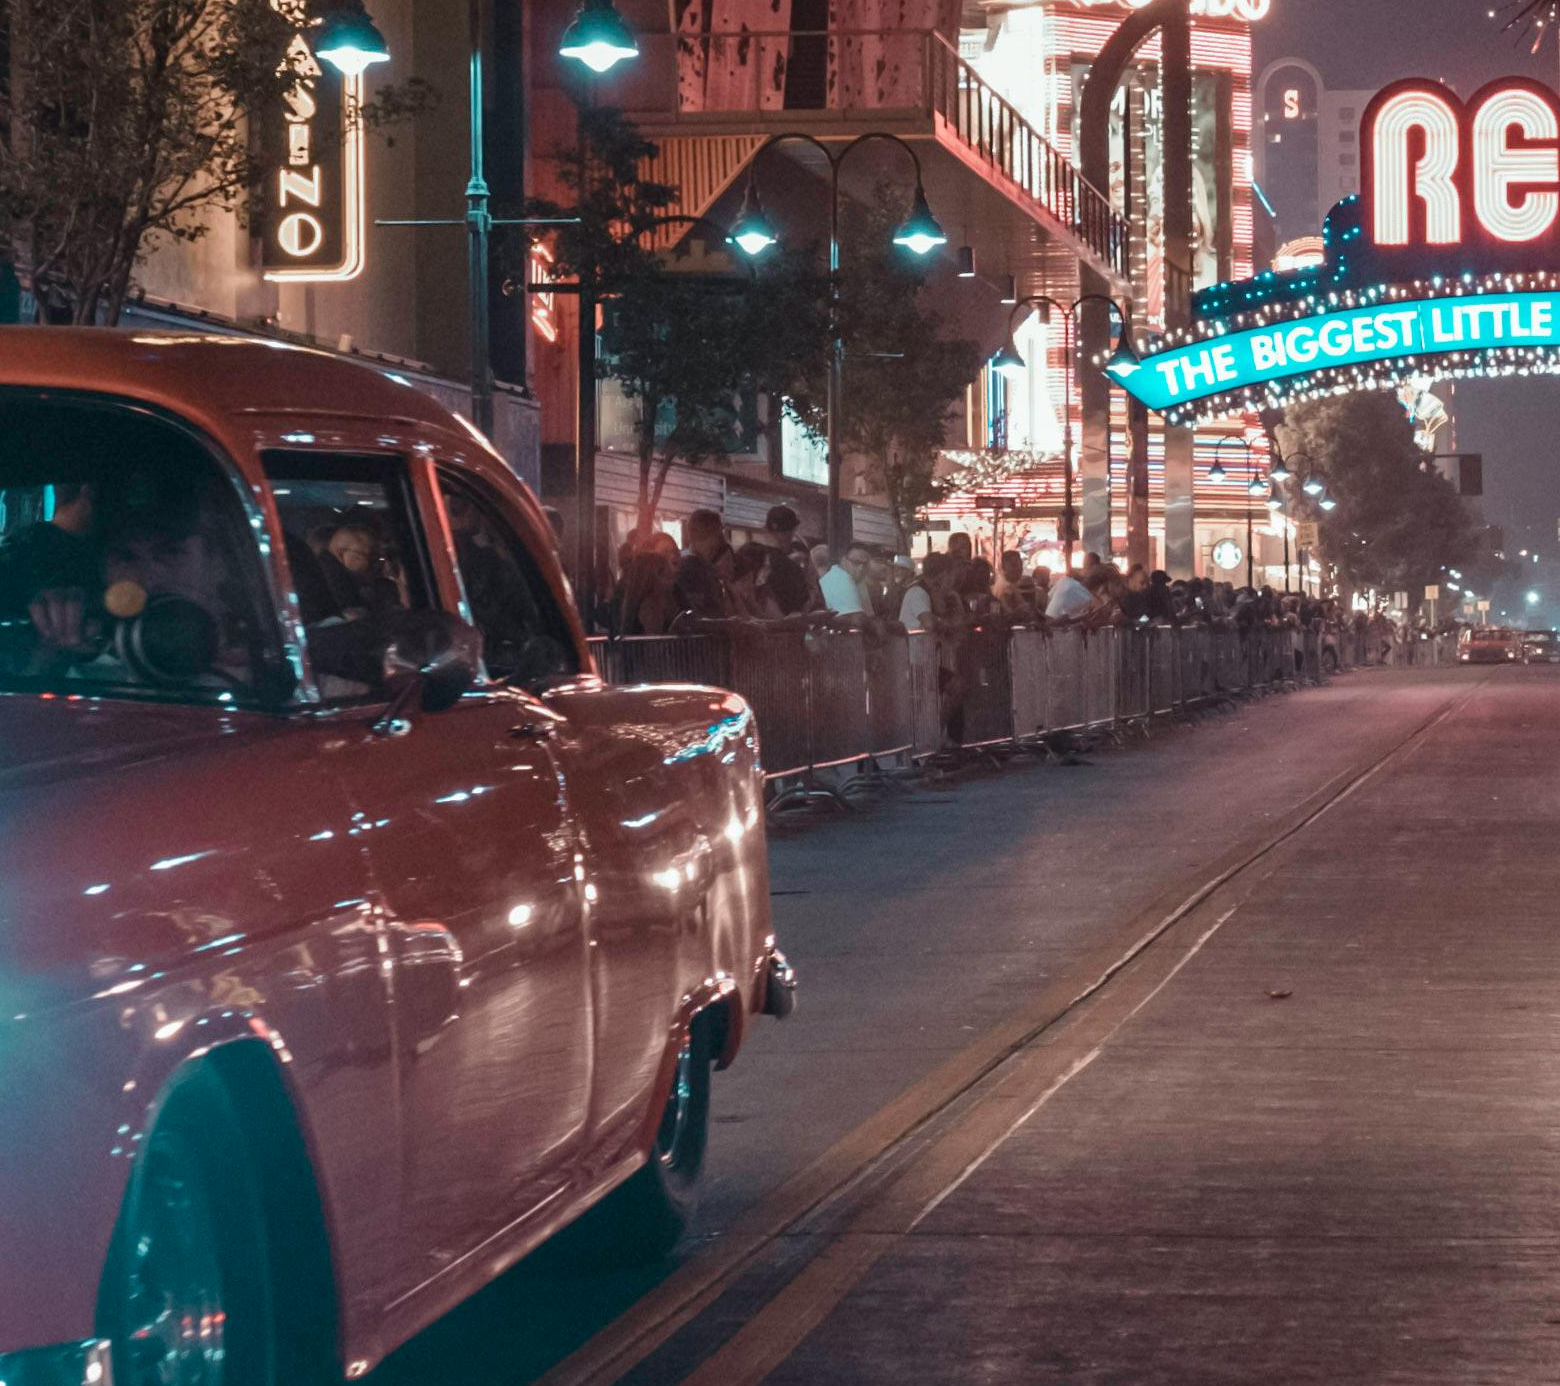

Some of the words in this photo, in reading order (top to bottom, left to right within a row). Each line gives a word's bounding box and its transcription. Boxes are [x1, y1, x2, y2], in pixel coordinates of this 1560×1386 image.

[1155, 344, 1237, 396] THE
[1250, 310, 1418, 371] BIGGEST
[1432, 301, 1552, 343] LITTLE
